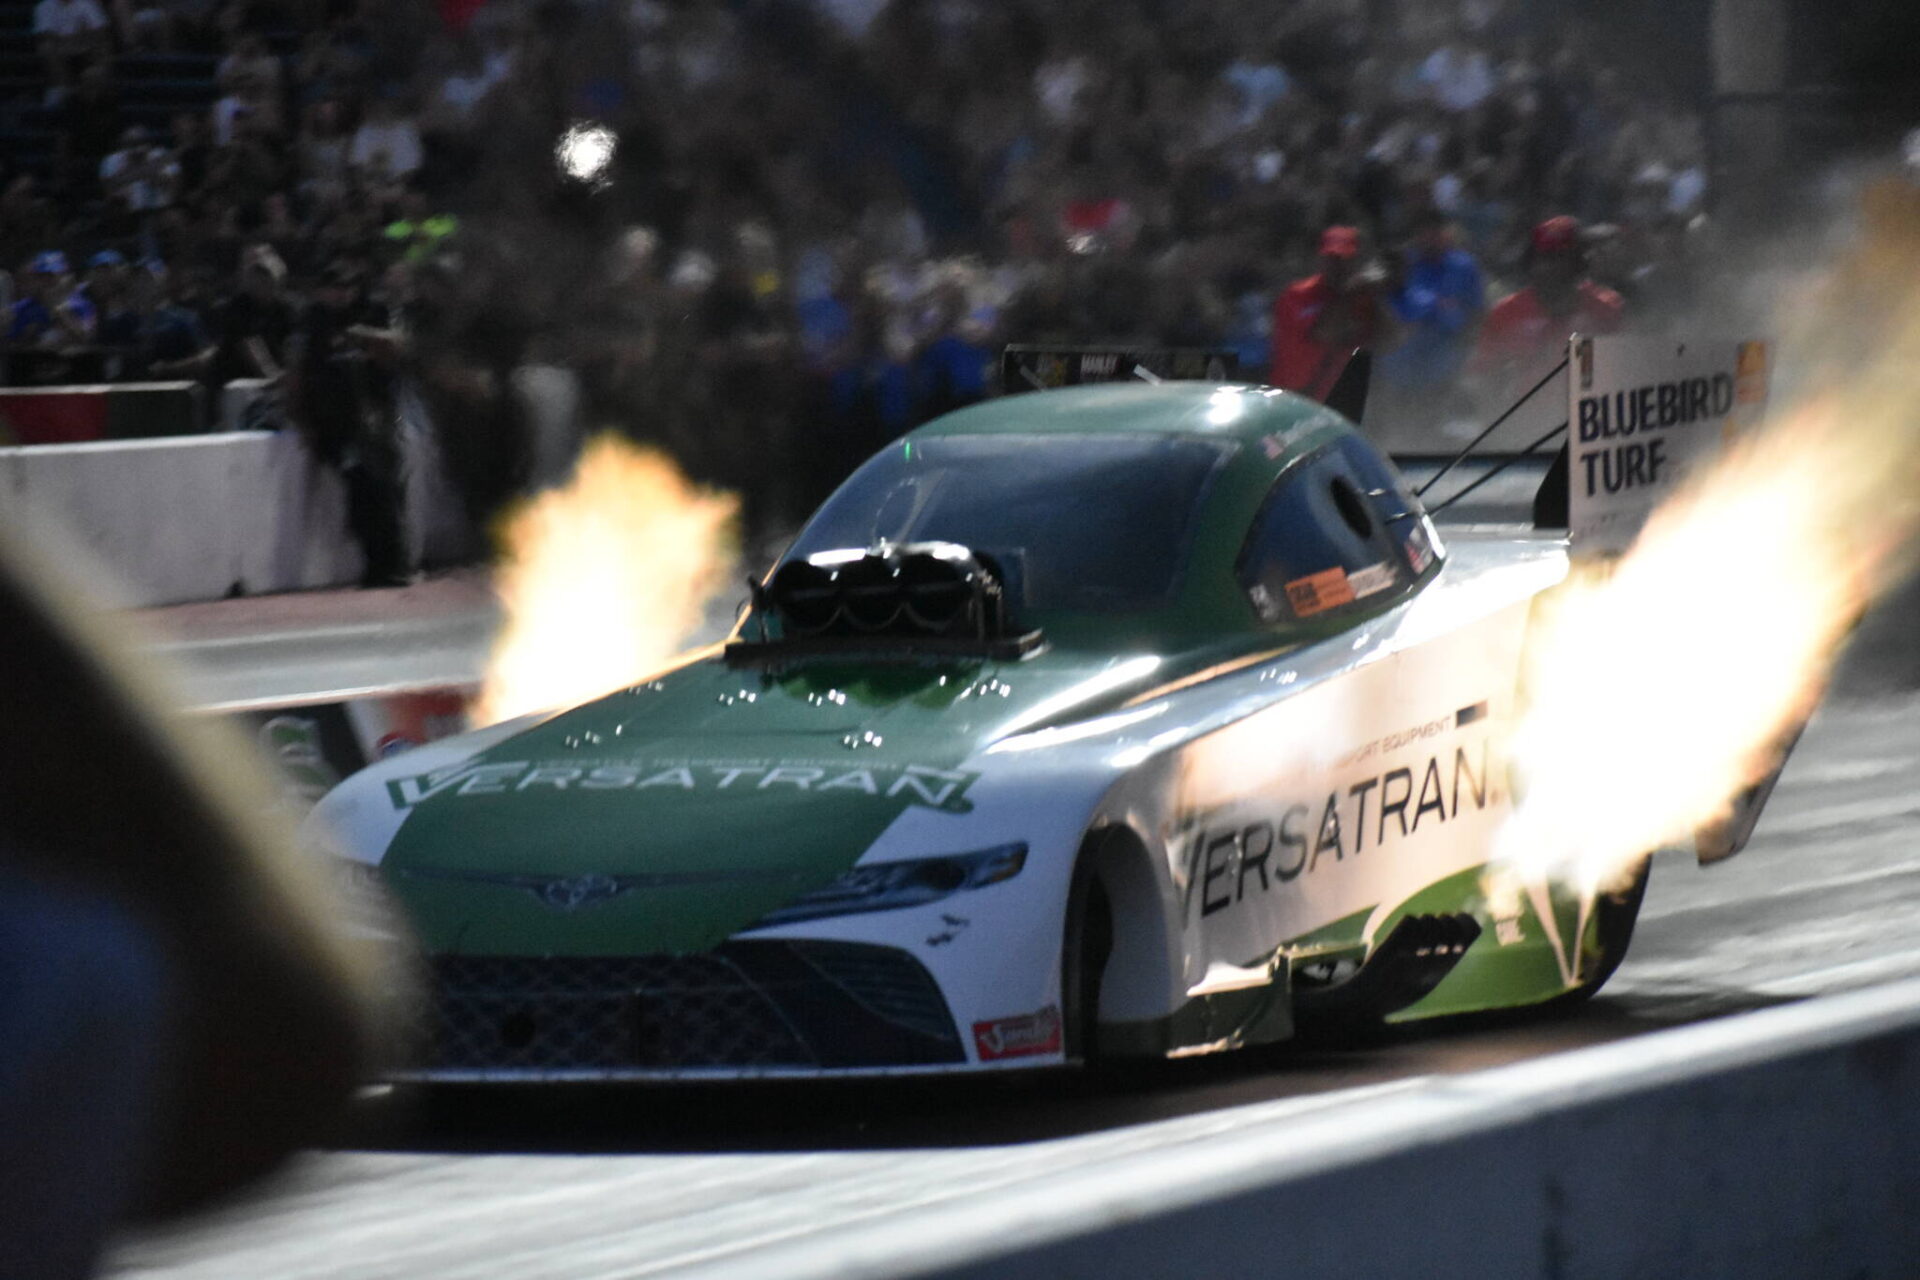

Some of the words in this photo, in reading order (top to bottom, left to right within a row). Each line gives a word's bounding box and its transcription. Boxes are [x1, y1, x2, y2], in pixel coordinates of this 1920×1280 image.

[1579, 372, 1733, 443] BLUEBIRD
[1580, 438, 1667, 497] TURF
[1382, 715, 1452, 752] EQUIPMENT
[392, 759, 970, 808] VERSATRAN
